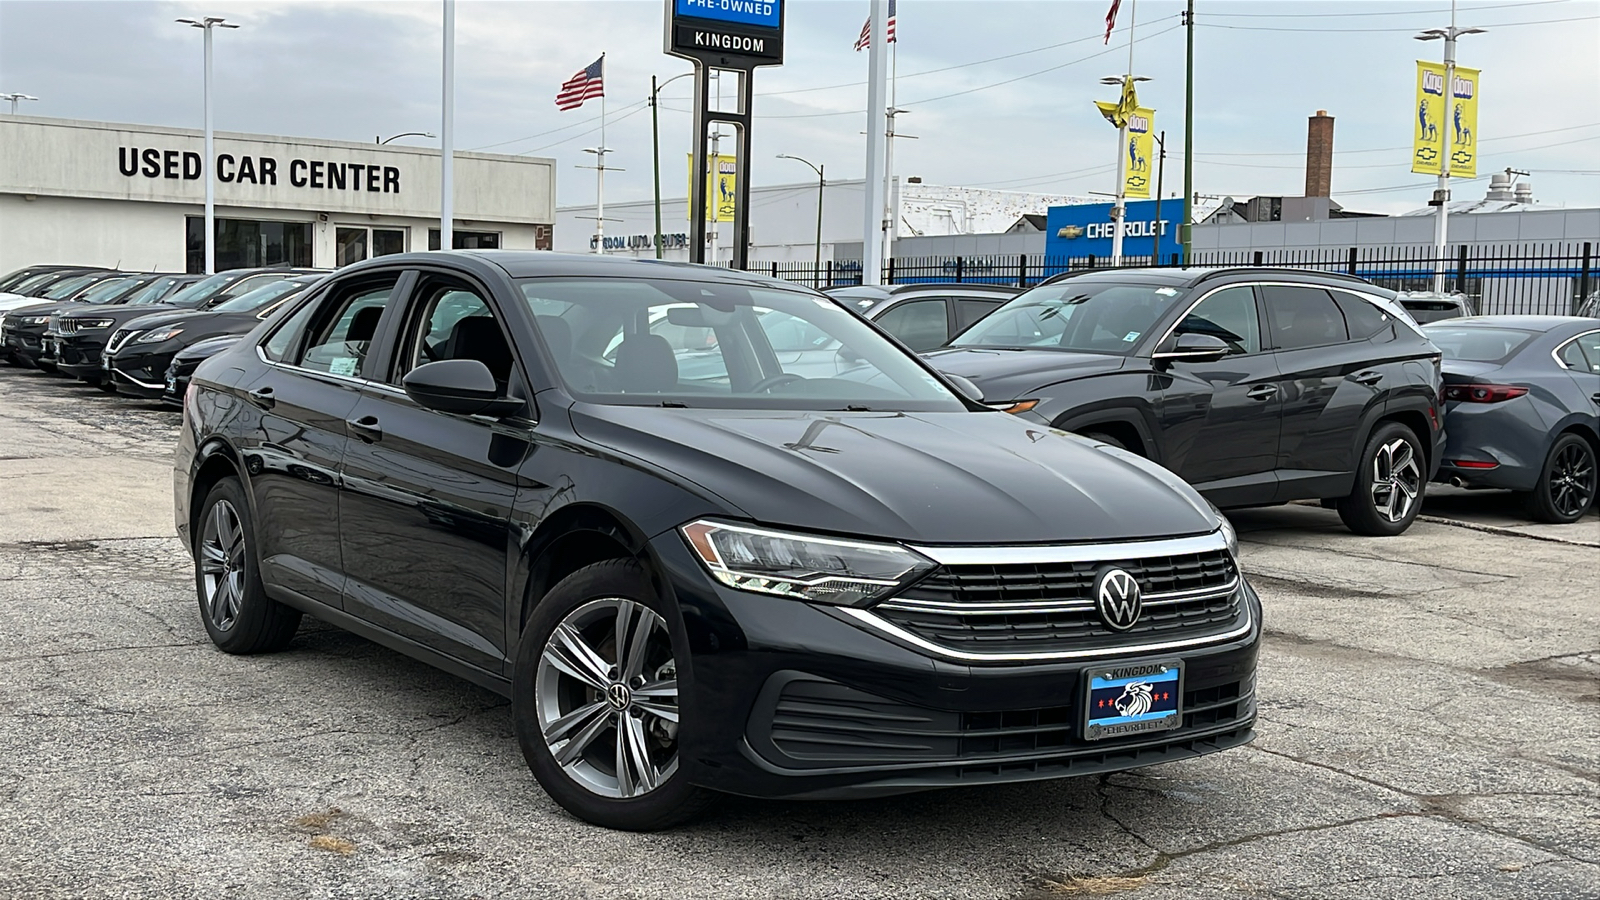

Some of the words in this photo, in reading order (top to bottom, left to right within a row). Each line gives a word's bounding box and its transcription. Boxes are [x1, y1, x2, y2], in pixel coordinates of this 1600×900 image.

[695, 31, 764, 52] KINGDOM
[1423, 70, 1443, 96] King
[1453, 75, 1473, 99] dom
[1129, 113, 1148, 133] dom
[119, 147, 202, 180] USED
[216, 153, 277, 186] CAR
[290, 159, 400, 193] CENTER
[1111, 664, 1162, 679] KINGDOM
